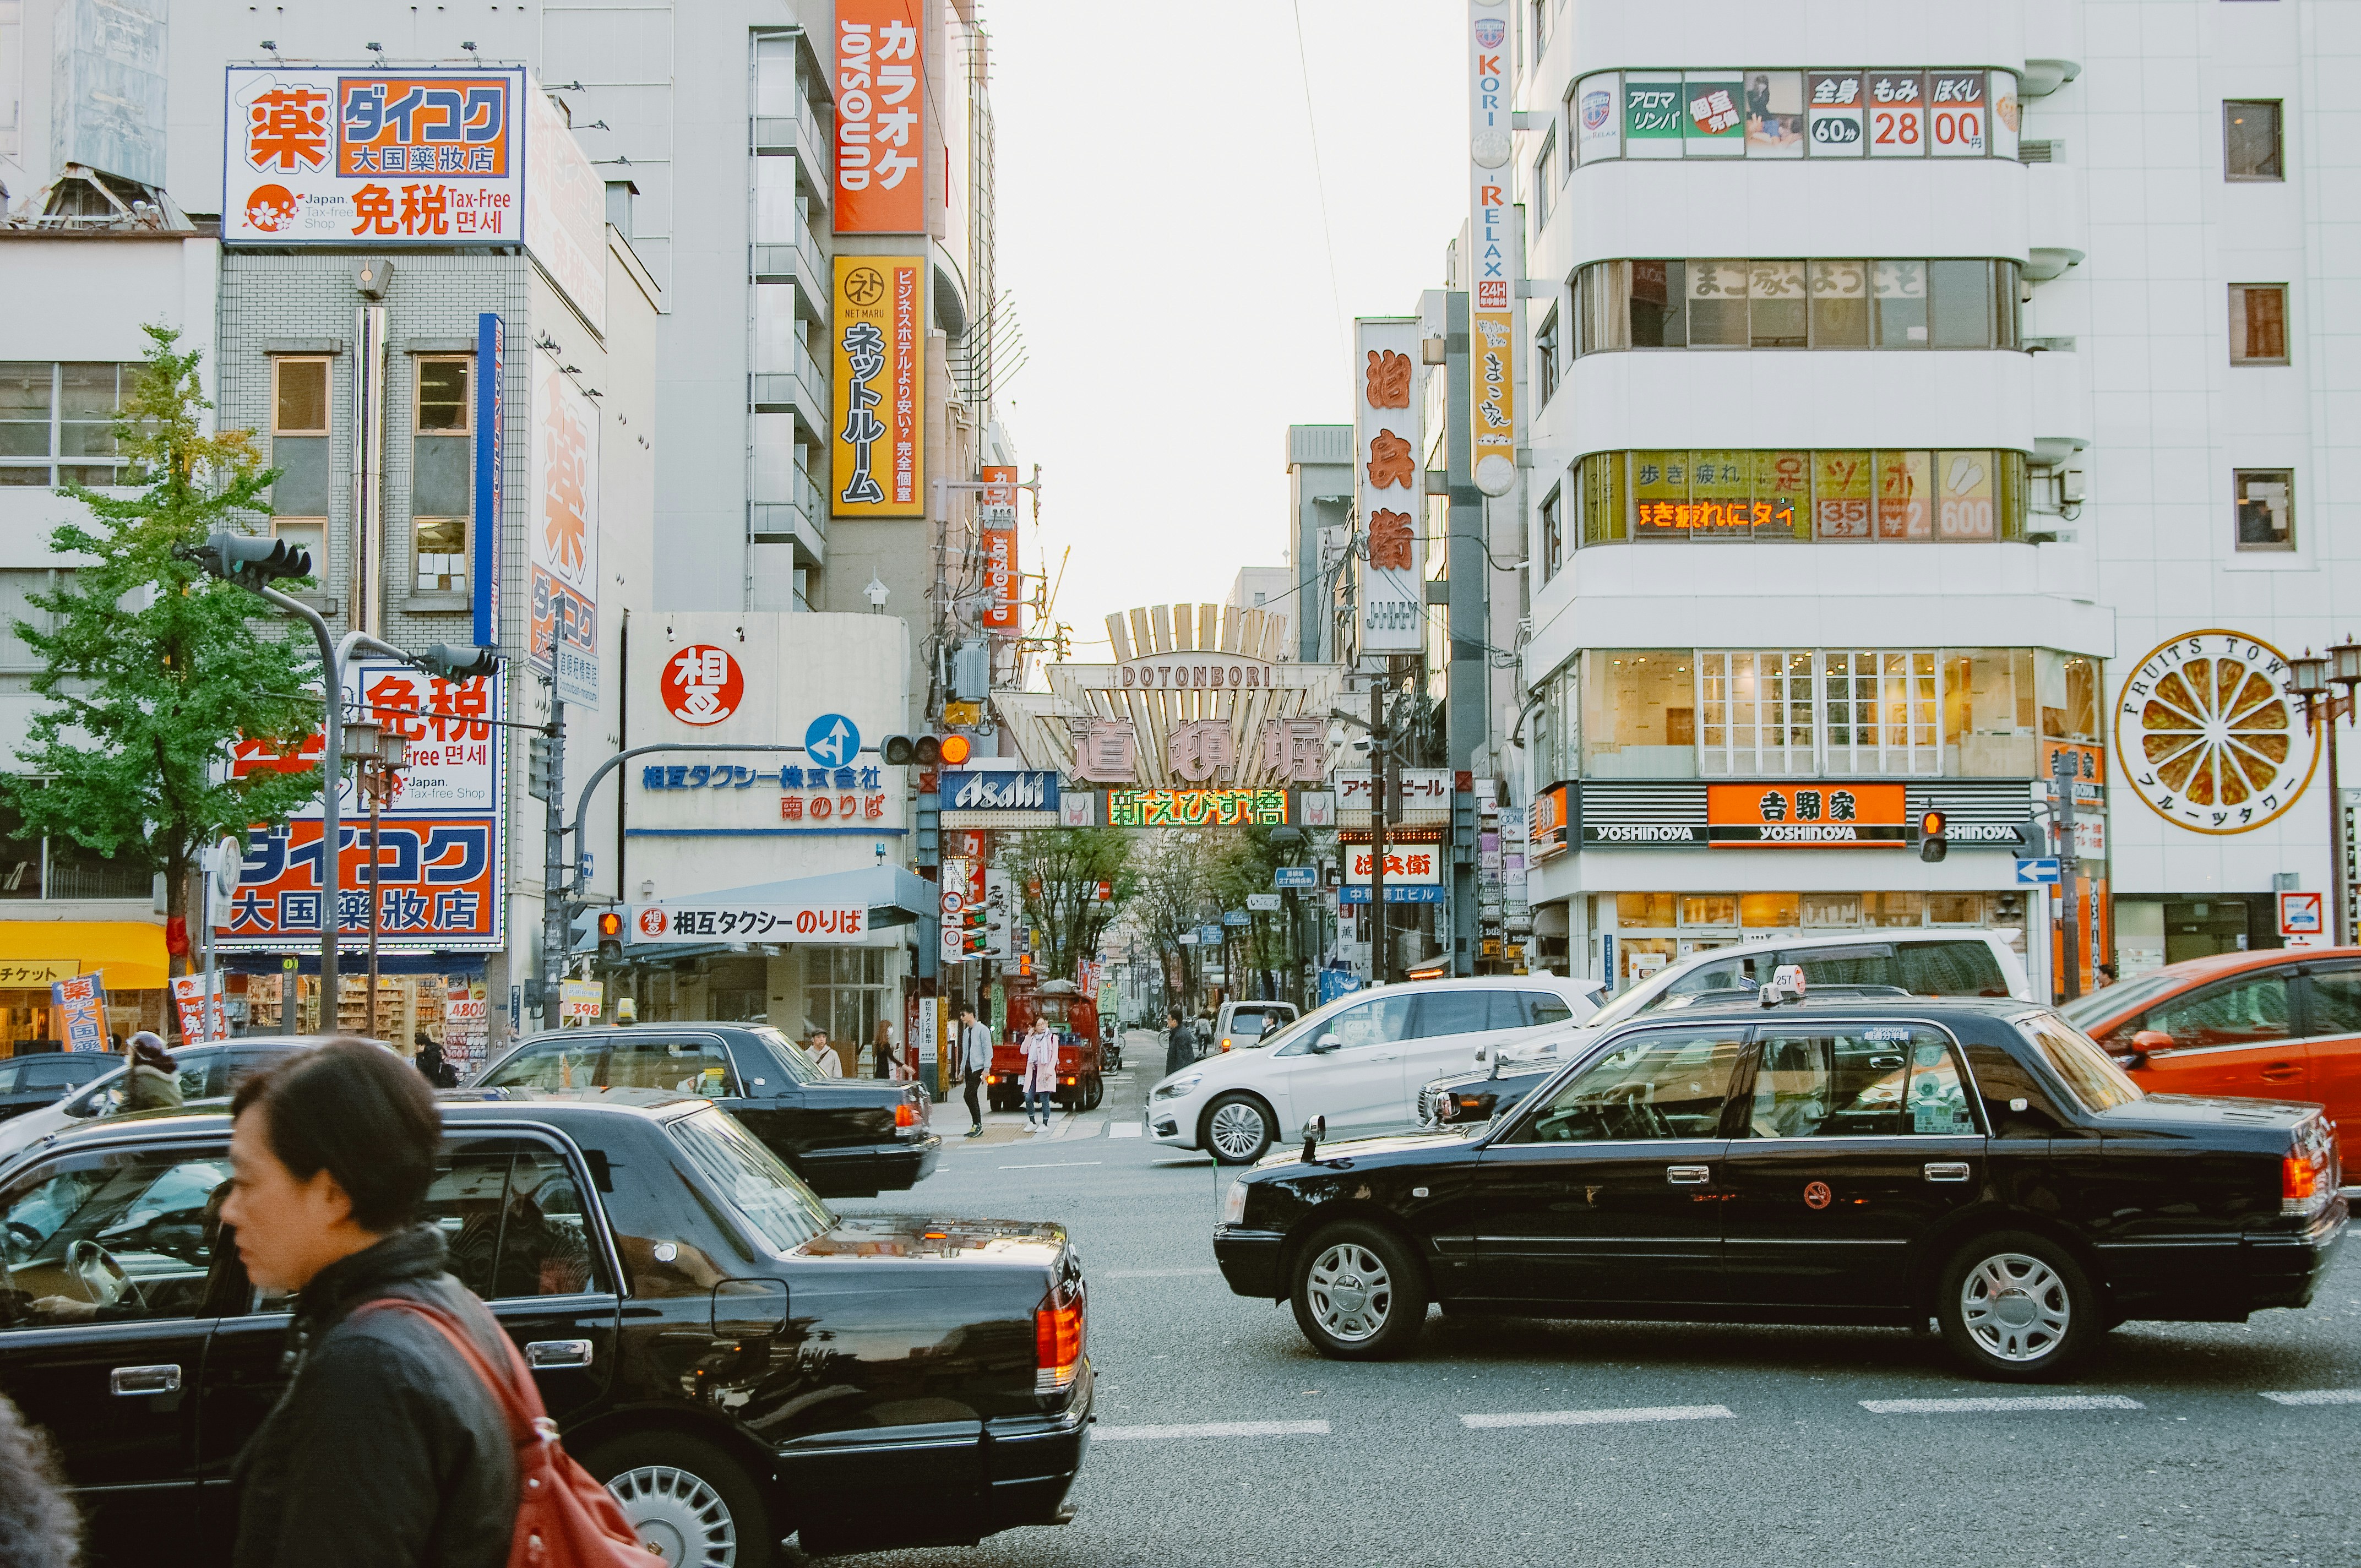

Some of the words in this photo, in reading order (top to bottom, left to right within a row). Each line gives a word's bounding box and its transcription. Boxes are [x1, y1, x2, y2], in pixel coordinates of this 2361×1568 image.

[1479, 55, 1501, 127] KORI
[1628, 91, 1675, 108] アロマ
[1813, 79, 1859, 105] 全身
[1874, 79, 1919, 103] もみ
[1933, 79, 1981, 103] ほぐし
[344, 85, 503, 144] ダイコク
[839, 20, 872, 191] JOYSOUND
[873, 20, 918, 190] カラオケ
[1689, 90, 1734, 121] 個室
[250, 90, 327, 168] 薬
[1634, 111, 1680, 130] リンパ
[1710, 111, 1740, 133] 完備
[1816, 119, 1859, 141] 60分
[306, 194, 348, 205] Japan.
[351, 183, 449, 236] 免税
[449, 188, 511, 209] Tax-Free
[306, 206, 353, 217] Tax-free
[456, 210, 503, 235] 면세
[305, 218, 336, 230] Shop
[1481, 282, 1506, 297] 24H
[845, 309, 860, 318] NET
[862, 309, 884, 318] MARU
[841, 322, 887, 504] ネットルーム
[896, 441, 912, 503] 完全個室
[545, 405, 587, 573] 薬
[1123, 666, 1270, 688] DOTONBORI
[2123, 638, 2202, 716] FRUITS
[366, 675, 490, 742] 免税
[445, 745, 486, 765] 면세
[1071, 717, 1325, 782] 道頓堀
[409, 777, 448, 788] Japan.
[409, 788, 453, 798] Tax-free
[457, 788, 485, 799] Shop
[955, 772, 1044, 809] Asahi
[1342, 780, 1445, 797] アサビール
[780, 794, 885, 820] 南のりば
[1108, 789, 1288, 826] 新えびす橋
[1759, 790, 1857, 822] 吉野家
[2138, 772, 2295, 826] フルーツタワー
[1597, 825, 1694, 841] YOSHINOYA
[1759, 825, 1857, 841] YOSHINOYA
[1944, 825, 2017, 841] SHINOYA
[0, 967, 57, 982] チケット
[1776, 975, 1792, 985] 257
[180, 1000, 221, 1013] Tax-Fe
[573, 1004, 600, 1016] 398
